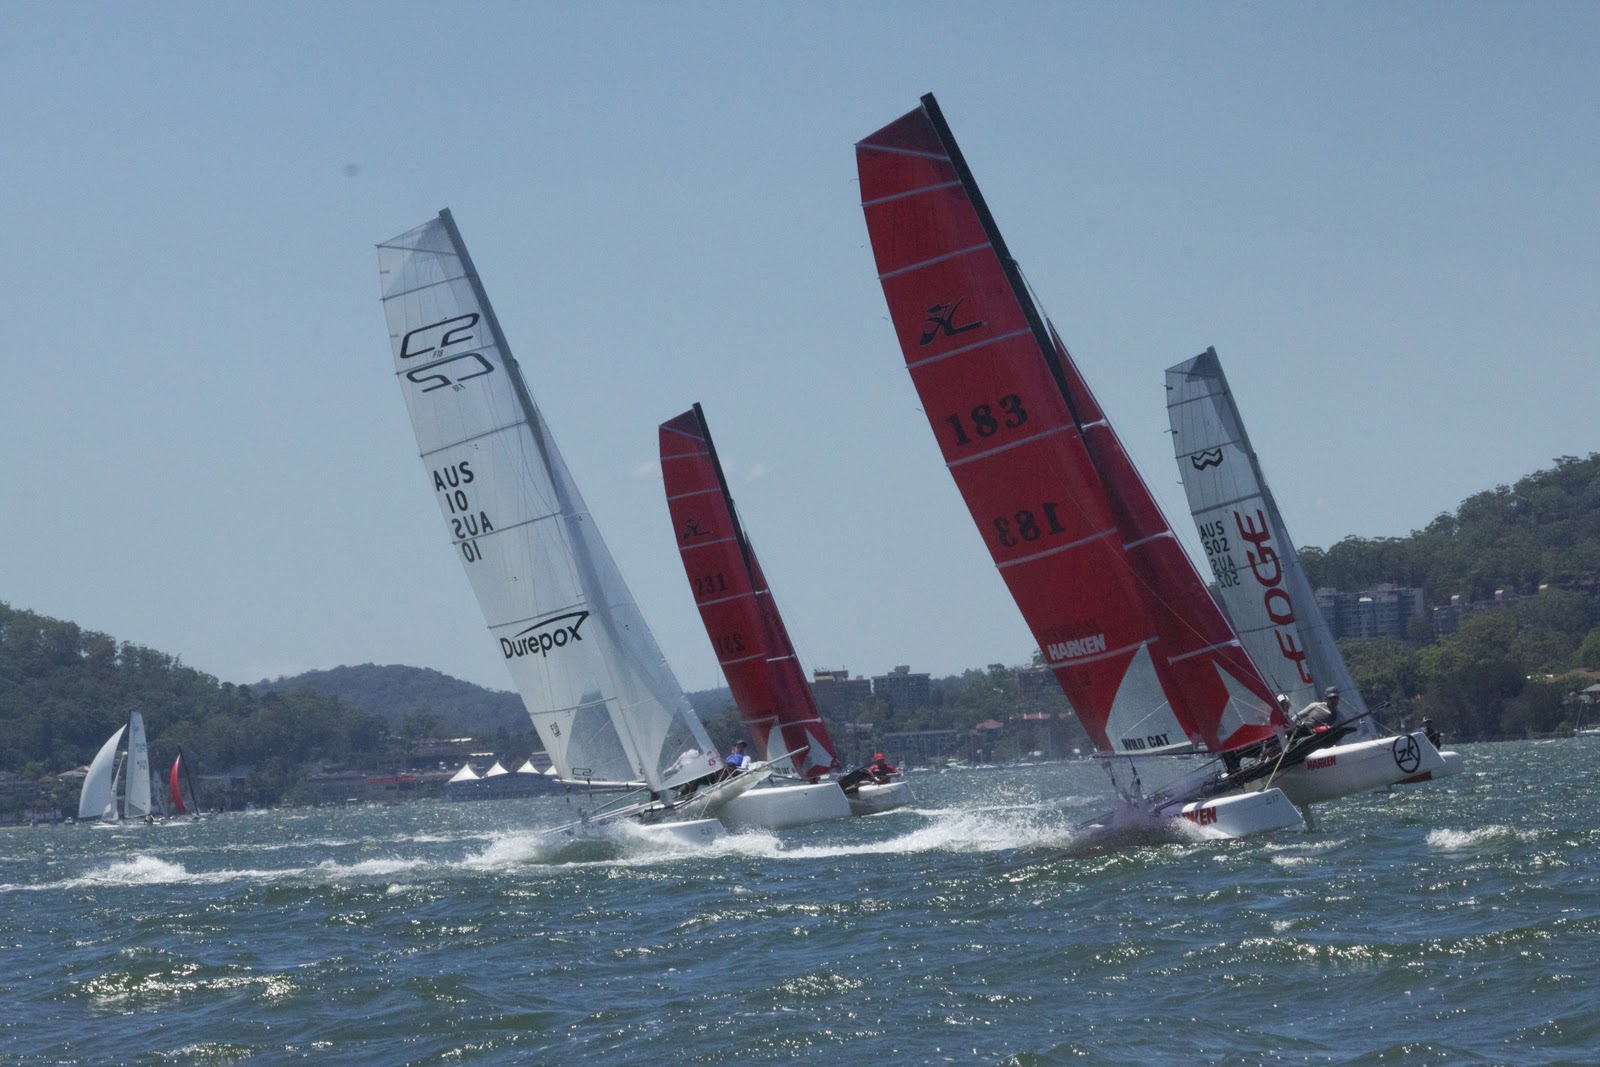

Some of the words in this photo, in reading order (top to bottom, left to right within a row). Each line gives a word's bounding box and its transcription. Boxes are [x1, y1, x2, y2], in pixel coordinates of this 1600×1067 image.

[947, 394, 1028, 446] 183
[433, 461, 474, 492] AUS
[445, 490, 468, 514] 10
[1200, 520, 1225, 540] AUS
[1204, 537, 1231, 556] 502
[499, 610, 589, 659] Durepox
[1047, 633, 1107, 660] HARKEN
[1121, 738, 1146, 751] WILD
[1147, 733, 1170, 748] CAT
[1306, 755, 1337, 770] HARKEN
